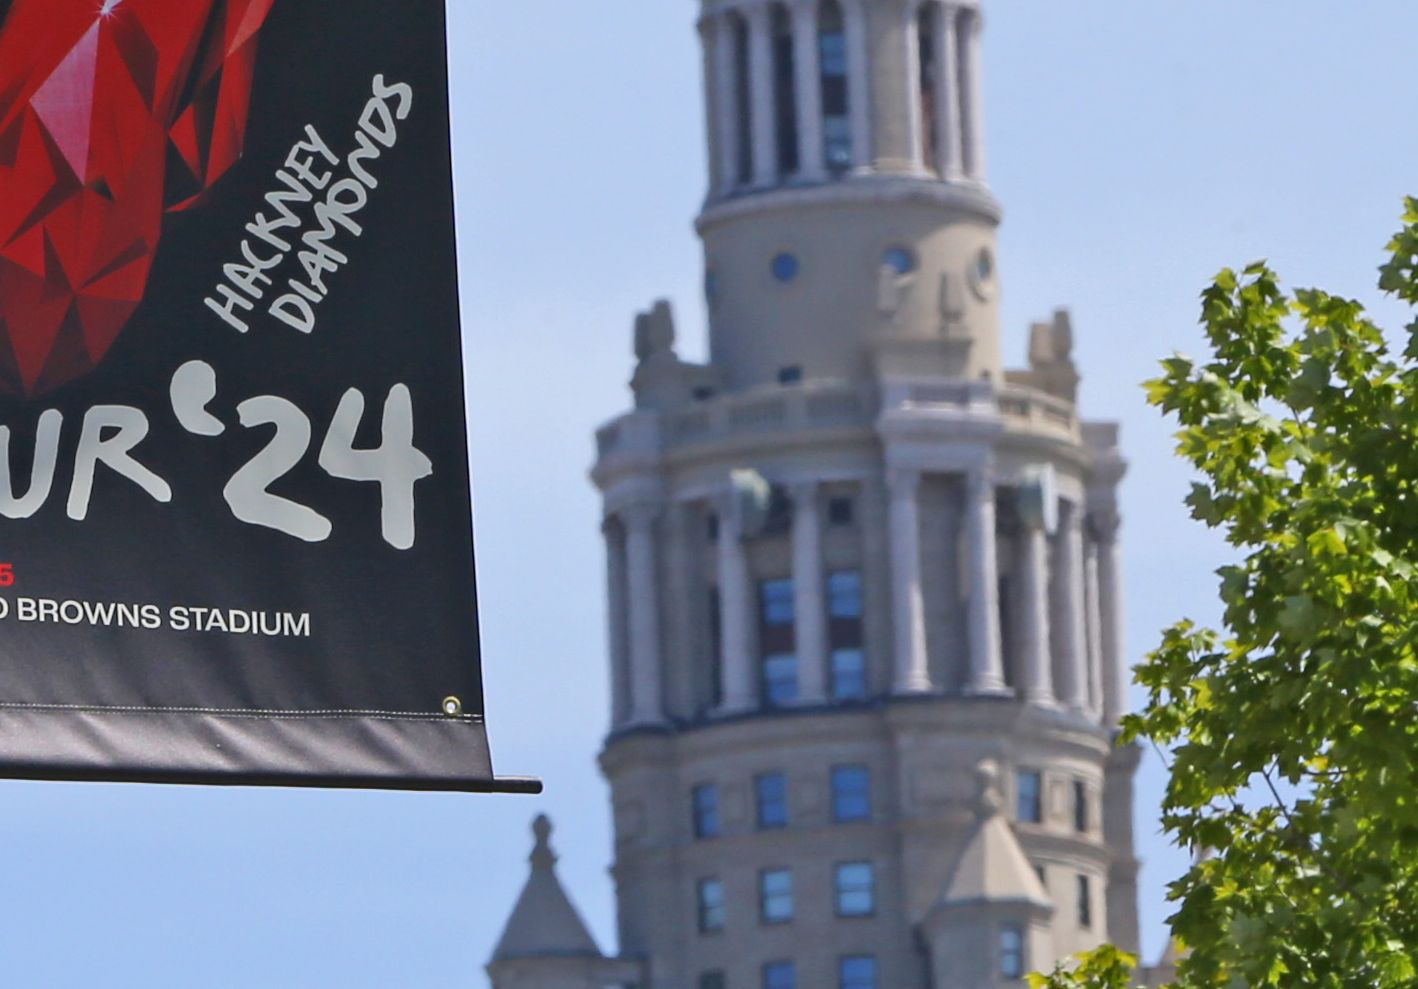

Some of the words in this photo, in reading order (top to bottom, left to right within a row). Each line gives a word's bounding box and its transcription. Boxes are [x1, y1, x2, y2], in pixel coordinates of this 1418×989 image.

[203, 123, 340, 334] HACKNEY
[268, 73, 413, 334] DIAMONDS
[169, 359, 433, 550] '24
[16, 597, 162, 629] BROWNS
[169, 606, 311, 637] STADIUM
